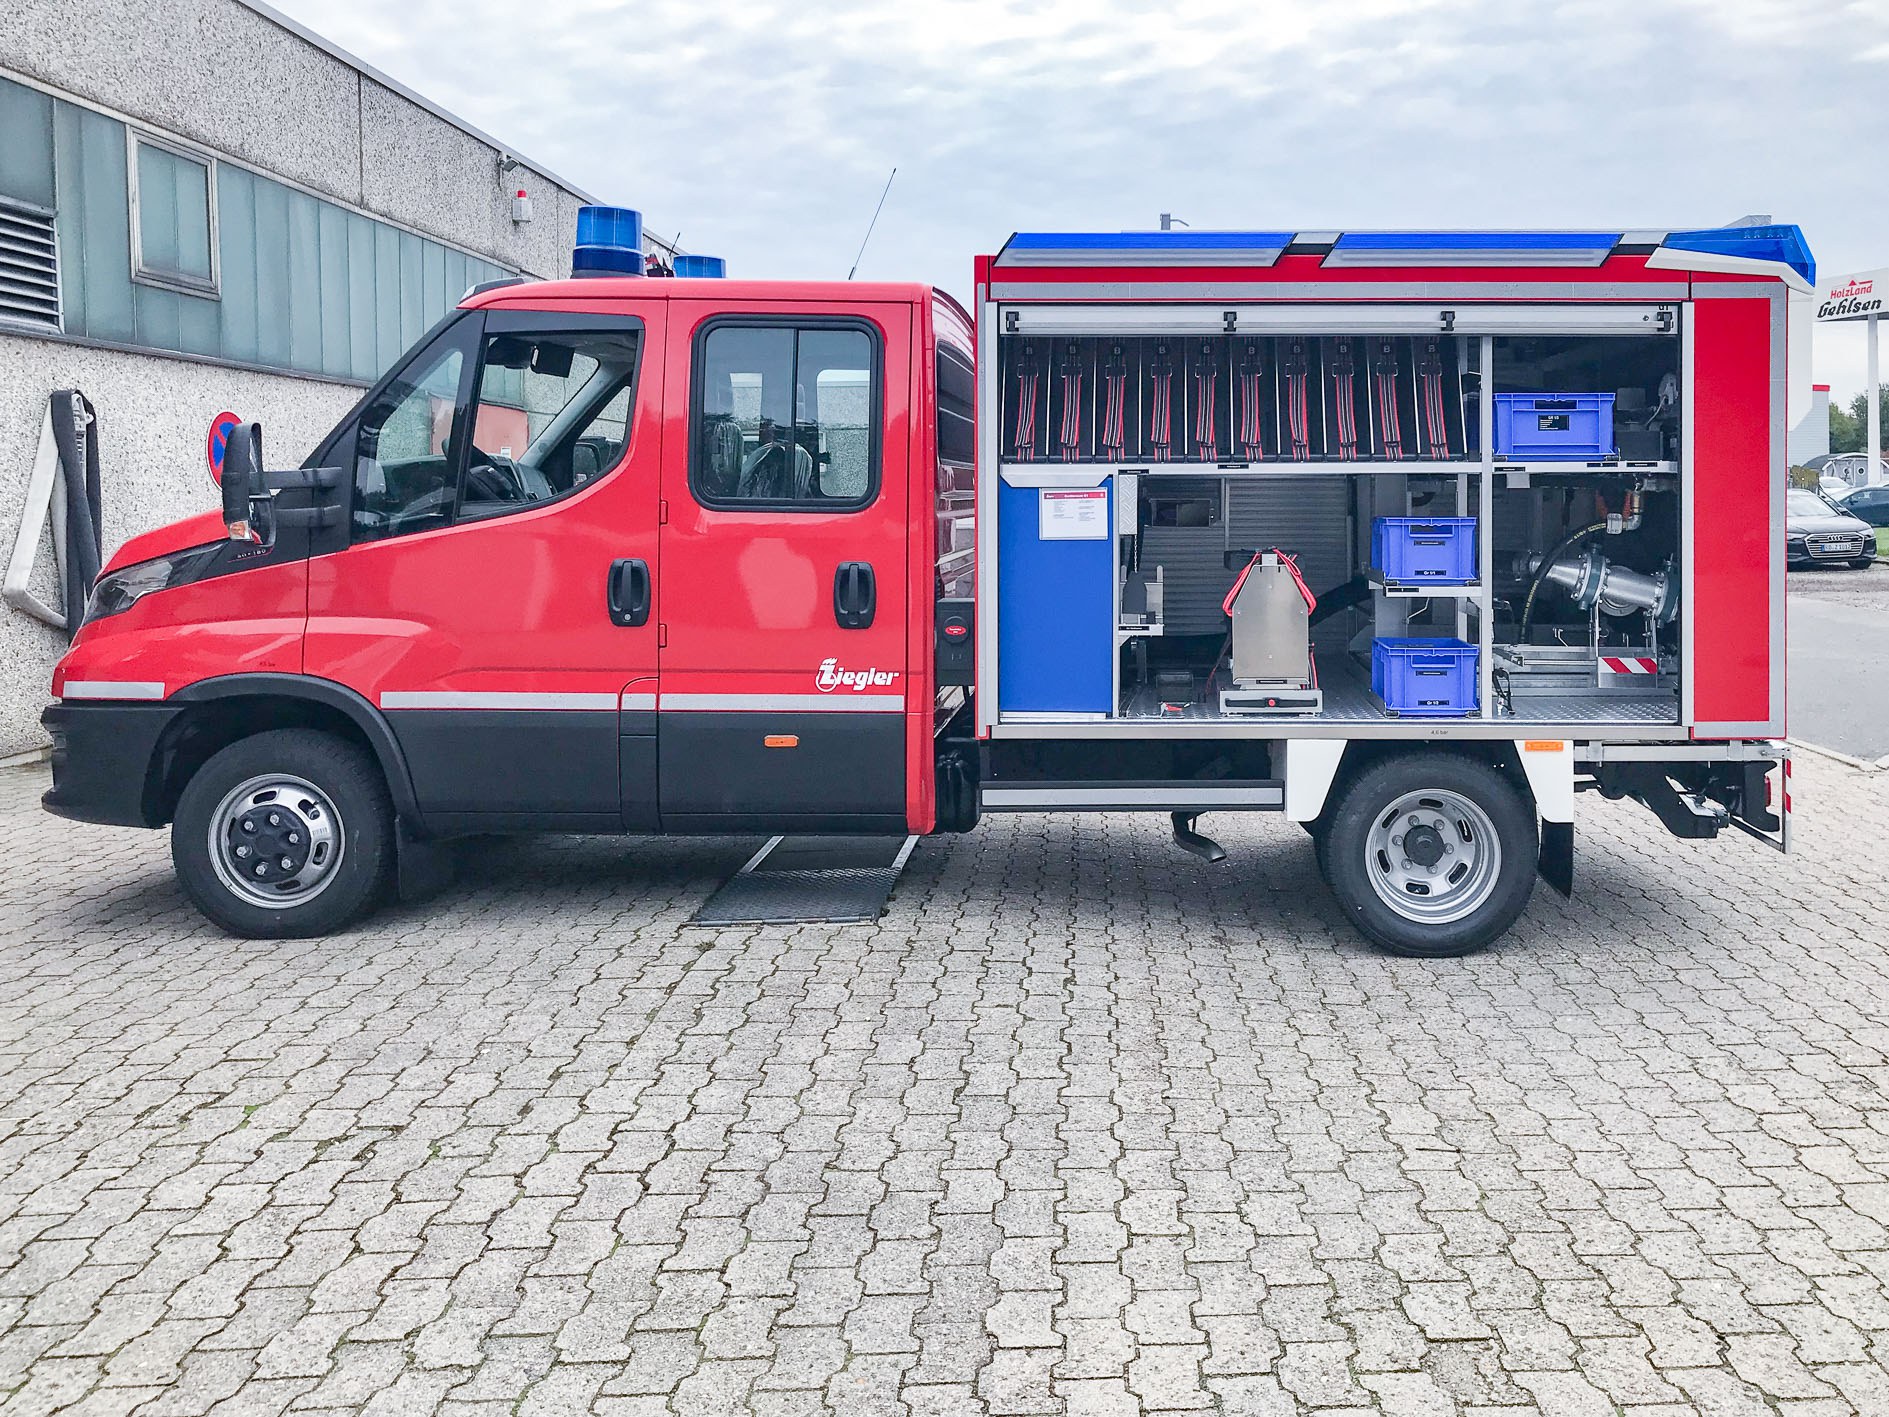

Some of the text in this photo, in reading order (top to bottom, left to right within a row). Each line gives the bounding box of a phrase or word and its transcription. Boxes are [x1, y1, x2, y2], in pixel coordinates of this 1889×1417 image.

[1830, 283, 1873, 299] HolzLand
[1817, 296, 1882, 318] Gehlsen
[816, 658, 899, 692] Ziegler
